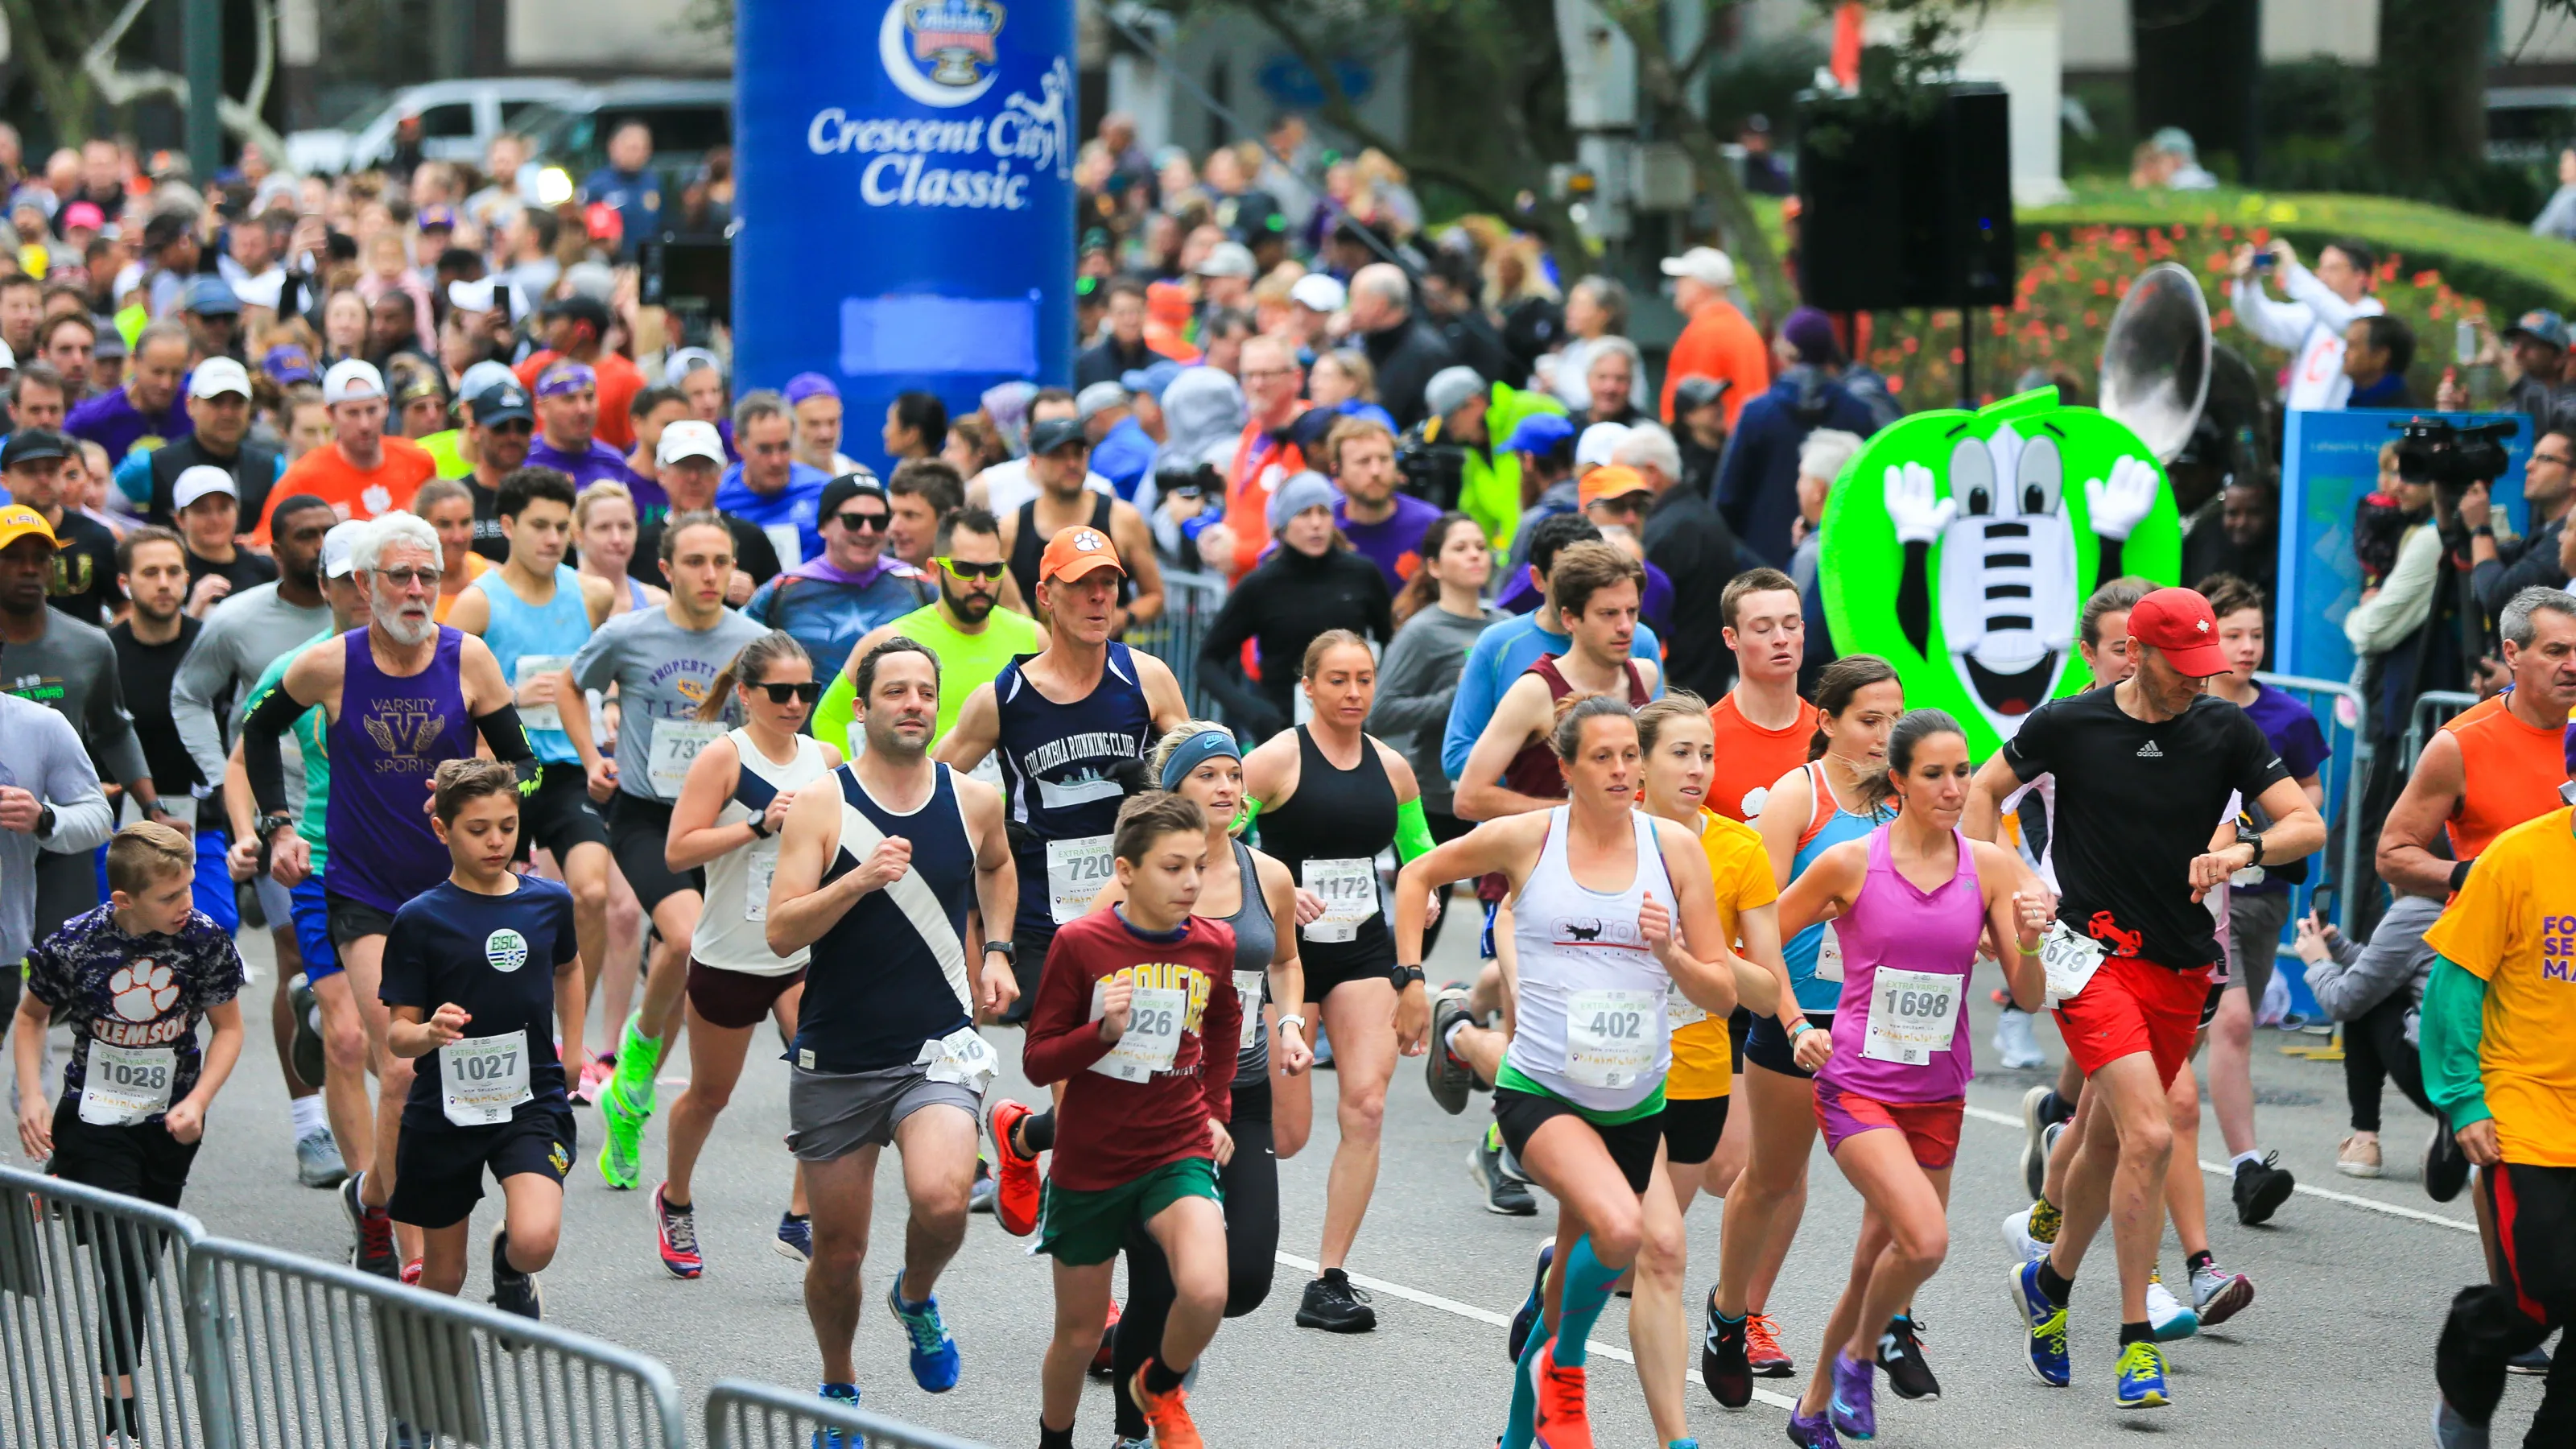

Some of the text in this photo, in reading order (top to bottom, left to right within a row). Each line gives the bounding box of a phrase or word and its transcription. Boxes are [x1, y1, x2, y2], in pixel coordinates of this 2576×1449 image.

[807, 107, 1055, 171] Crescent City
[861, 153, 1030, 210] Classic
[649, 658, 718, 687] PROPERTY
[34, 685, 64, 700] YARD
[371, 698, 436, 712] VARSITY
[1206, 734, 1223, 742] RUN
[374, 758, 435, 773] SPORTS
[1025, 733, 1135, 778] COLUMBIA RUNNING CLUB
[1059, 849, 1084, 858] EXTRA
[1086, 846, 1107, 854] YARD
[1067, 853, 1114, 881] 720
[1315, 876, 1368, 900] 1172
[491, 934, 518, 951] ESC
[1886, 980, 1914, 990] EXTRA
[1916, 984, 1938, 993] YARD
[1137, 1000, 1160, 1009] YARD
[1580, 1002, 1609, 1010] EXTRA
[1885, 989, 1949, 1018] 1698
[92, 1011, 189, 1045] CLEMSON
[1125, 1009, 1173, 1037] 026
[1590, 1012, 1641, 1039] 402
[101, 1052, 127, 1064] EXTRA
[130, 1057, 153, 1066] YARD
[449, 1043, 518, 1057] EXTRA YARD 5K
[100, 1061, 166, 1089] 1028
[452, 1051, 518, 1080] 1027
